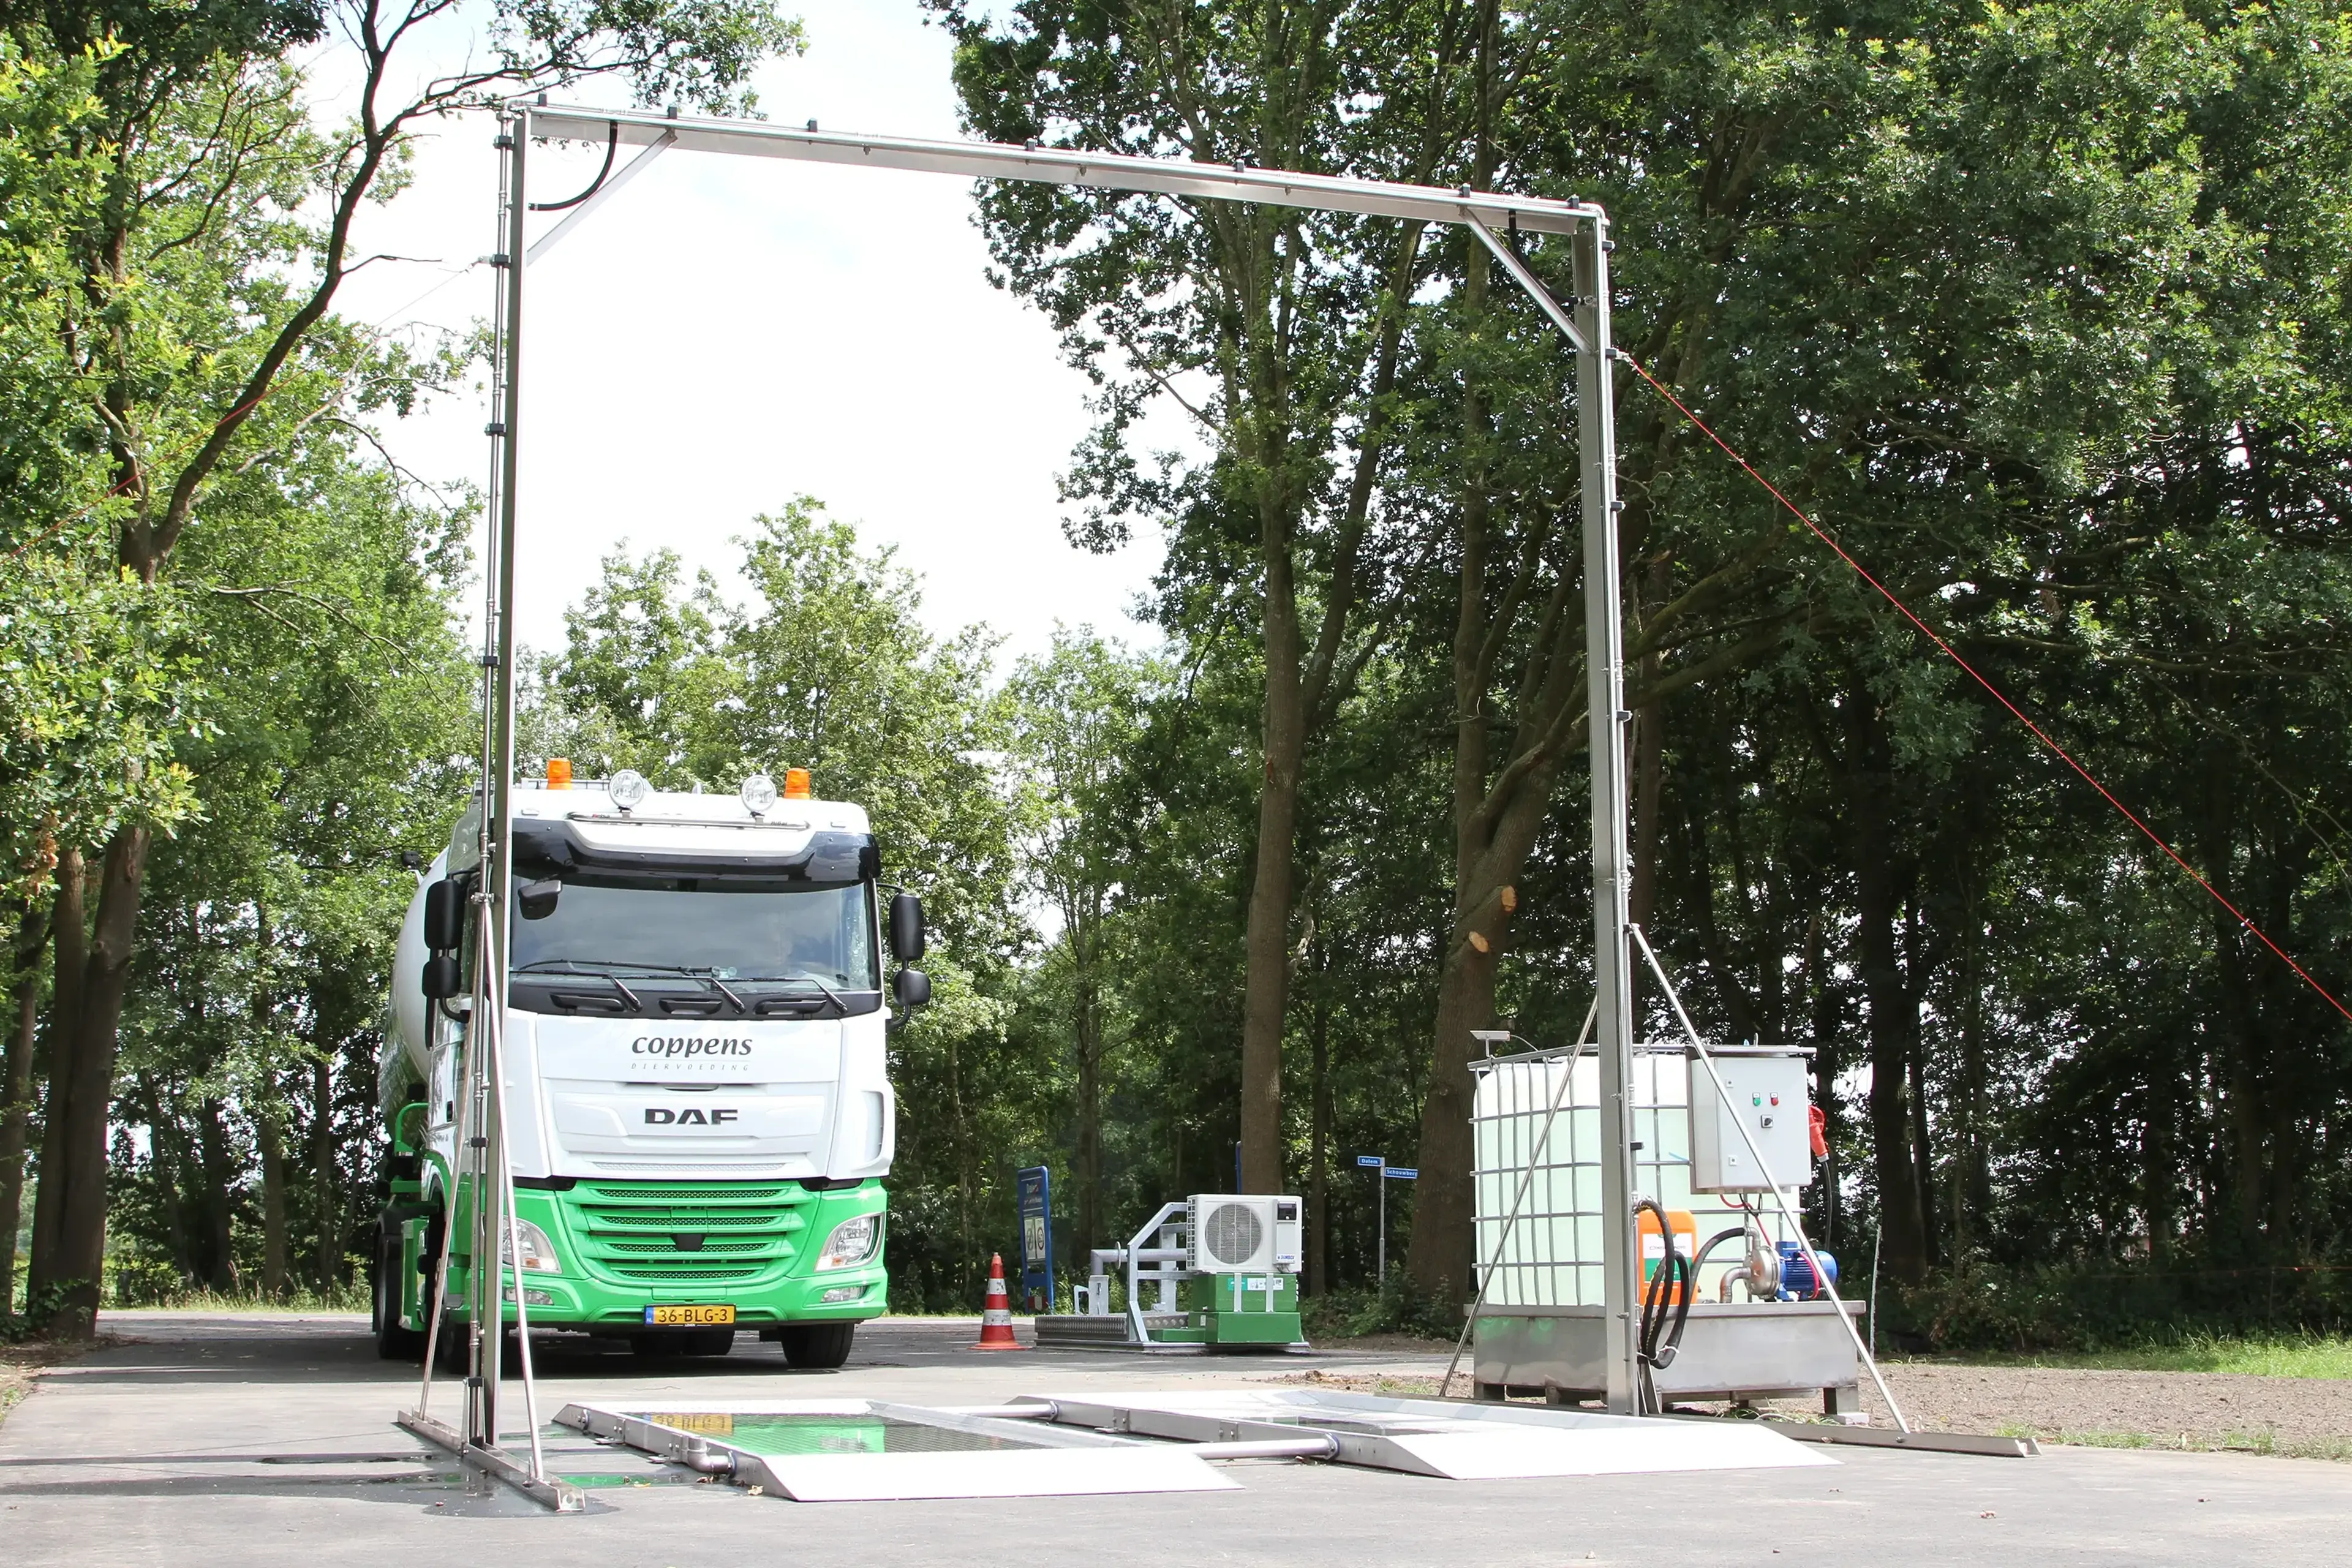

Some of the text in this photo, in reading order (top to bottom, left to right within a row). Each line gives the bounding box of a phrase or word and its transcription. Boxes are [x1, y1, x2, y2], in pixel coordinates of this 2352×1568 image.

[631, 1036, 753, 1058] coppens
[644, 1109, 738, 1125] DAF
[658, 1309, 728, 1322] 36-BLG-3
